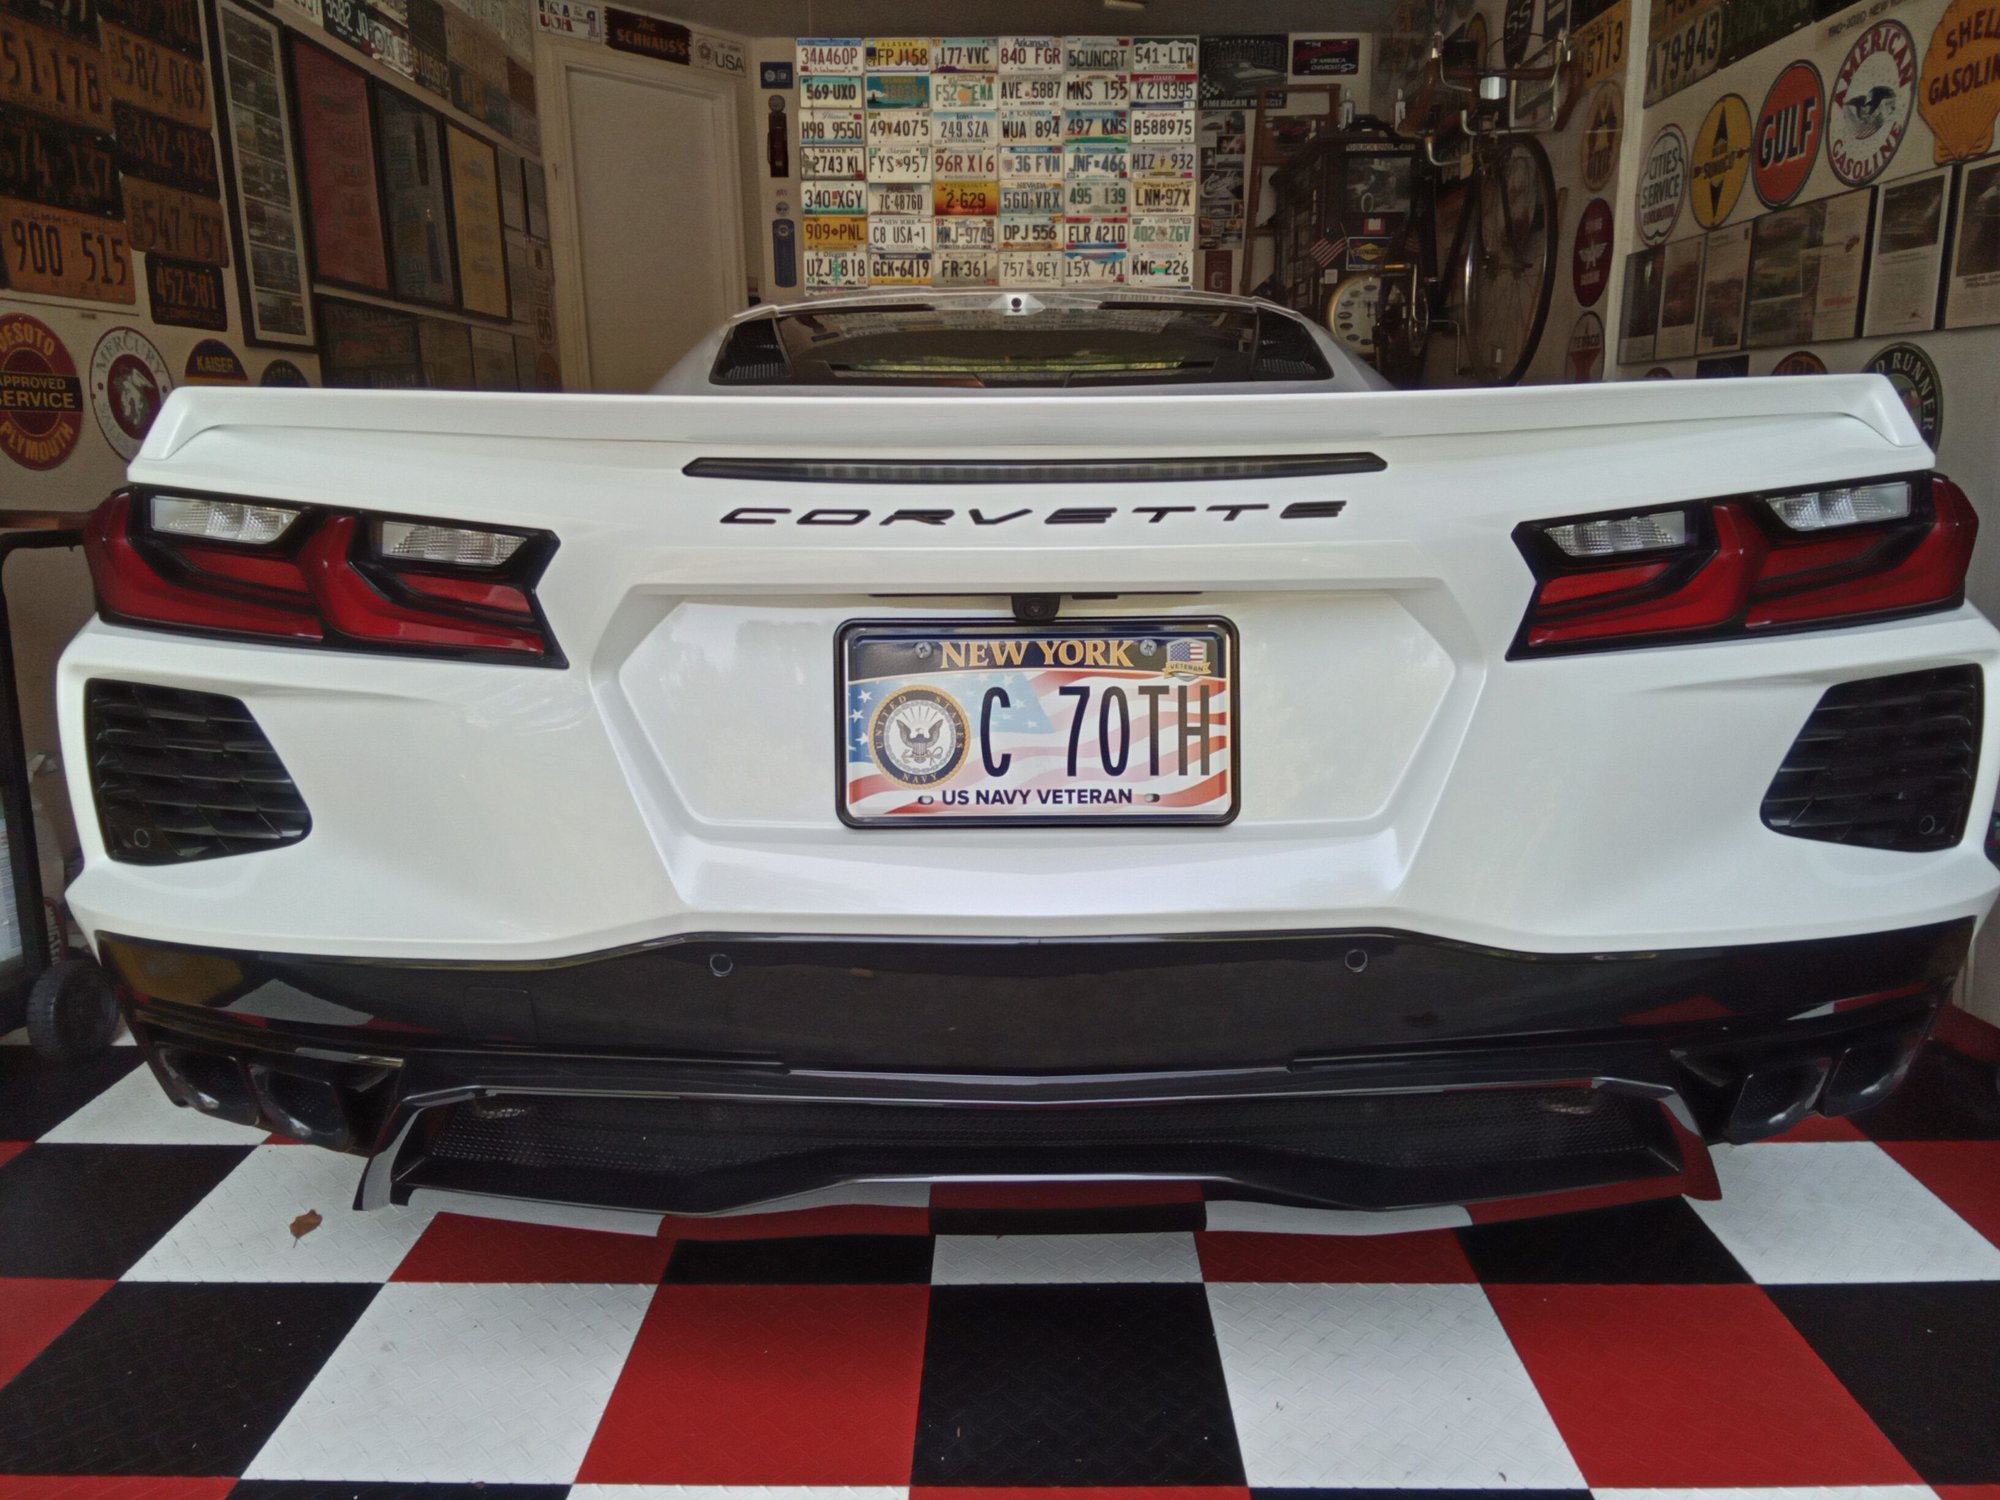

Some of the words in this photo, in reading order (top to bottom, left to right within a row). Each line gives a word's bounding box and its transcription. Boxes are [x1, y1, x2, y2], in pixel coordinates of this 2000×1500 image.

[1013, 38, 1050, 47] Arkansas
[714, 51, 745, 72] USA
[801, 47, 858, 65] 34A460P
[1001, 48, 1026, 65] 840
[1035, 48, 1061, 65] FGR
[1834, 22, 1914, 108] AMERICAN
[1929, 53, 2000, 105] GASOLIN
[1001, 81, 1023, 99] AVE
[1032, 81, 1061, 99] 5887
[1066, 82, 1093, 100] MNS
[1104, 82, 1128, 100] 155
[801, 121, 825, 139] H98
[940, 121, 962, 138] 249
[967, 121, 989, 138] SZA
[1002, 121, 1027, 139] WUA
[1035, 120, 1060, 138] 894
[1067, 119, 1093, 135] 497
[1102, 118, 1127, 135] KNS
[1759, 97, 1816, 169] GULF
[1170, 153, 1194, 170] 932
[1832, 122, 1904, 183] GASOLINE
[813, 155, 843, 173] 2743
[847, 155, 861, 173] KL
[869, 155, 894, 173] FYS
[903, 155, 928, 173] 957
[935, 155, 963, 172] 96R
[1100, 155, 1126, 172] 466
[1648, 146, 1679, 180] CITIES
[804, 189, 831, 208] 340
[837, 189, 863, 208] XGY
[1035, 190, 1060, 209] VRX
[1069, 187, 1093, 204] 495
[1104, 187, 1126, 204] 139
[1641, 174, 1680, 209] SERVICE
[805, 223, 830, 240] 909
[839, 223, 865, 241] PNL
[893, 226, 913, 243] USA
[1003, 225, 1028, 241] DPJ
[1032, 225, 1057, 241] 556
[1068, 226, 1091, 243] ELR
[1095, 225, 1126, 242] 4210
[11, 218, 63, 276] 900
[80, 231, 126, 285] 515
[806, 259, 832, 277] UZJ
[841, 259, 866, 277] 818
[1003, 262, 1024, 278] 757
[1066, 261, 1090, 277] 15X
[1100, 261, 1124, 278] 741
[1165, 260, 1188, 276] 226
[96, 334, 165, 375] MERCURY
[197, 354, 234, 372] KAISER
[1893, 351, 1936, 430] RUNNER
[0, 420, 74, 463] PLYMOUTH
[720, 500, 1347, 525] CORVETTE
[940, 640, 1028, 669] NEW
[1045, 640, 1134, 668] YORK
[1169, 663, 1204, 671] VETERAN
[874, 696, 907, 749] UNITED
[933, 696, 963, 749] STATES
[980, 686, 1012, 777] C
[1059, 685, 1211, 777] 70TH
[902, 771, 939, 784] NAVY
[942, 789, 973, 805] US
[976, 789, 1031, 805] NAVY
[1039, 789, 1132, 804] VETERAN
